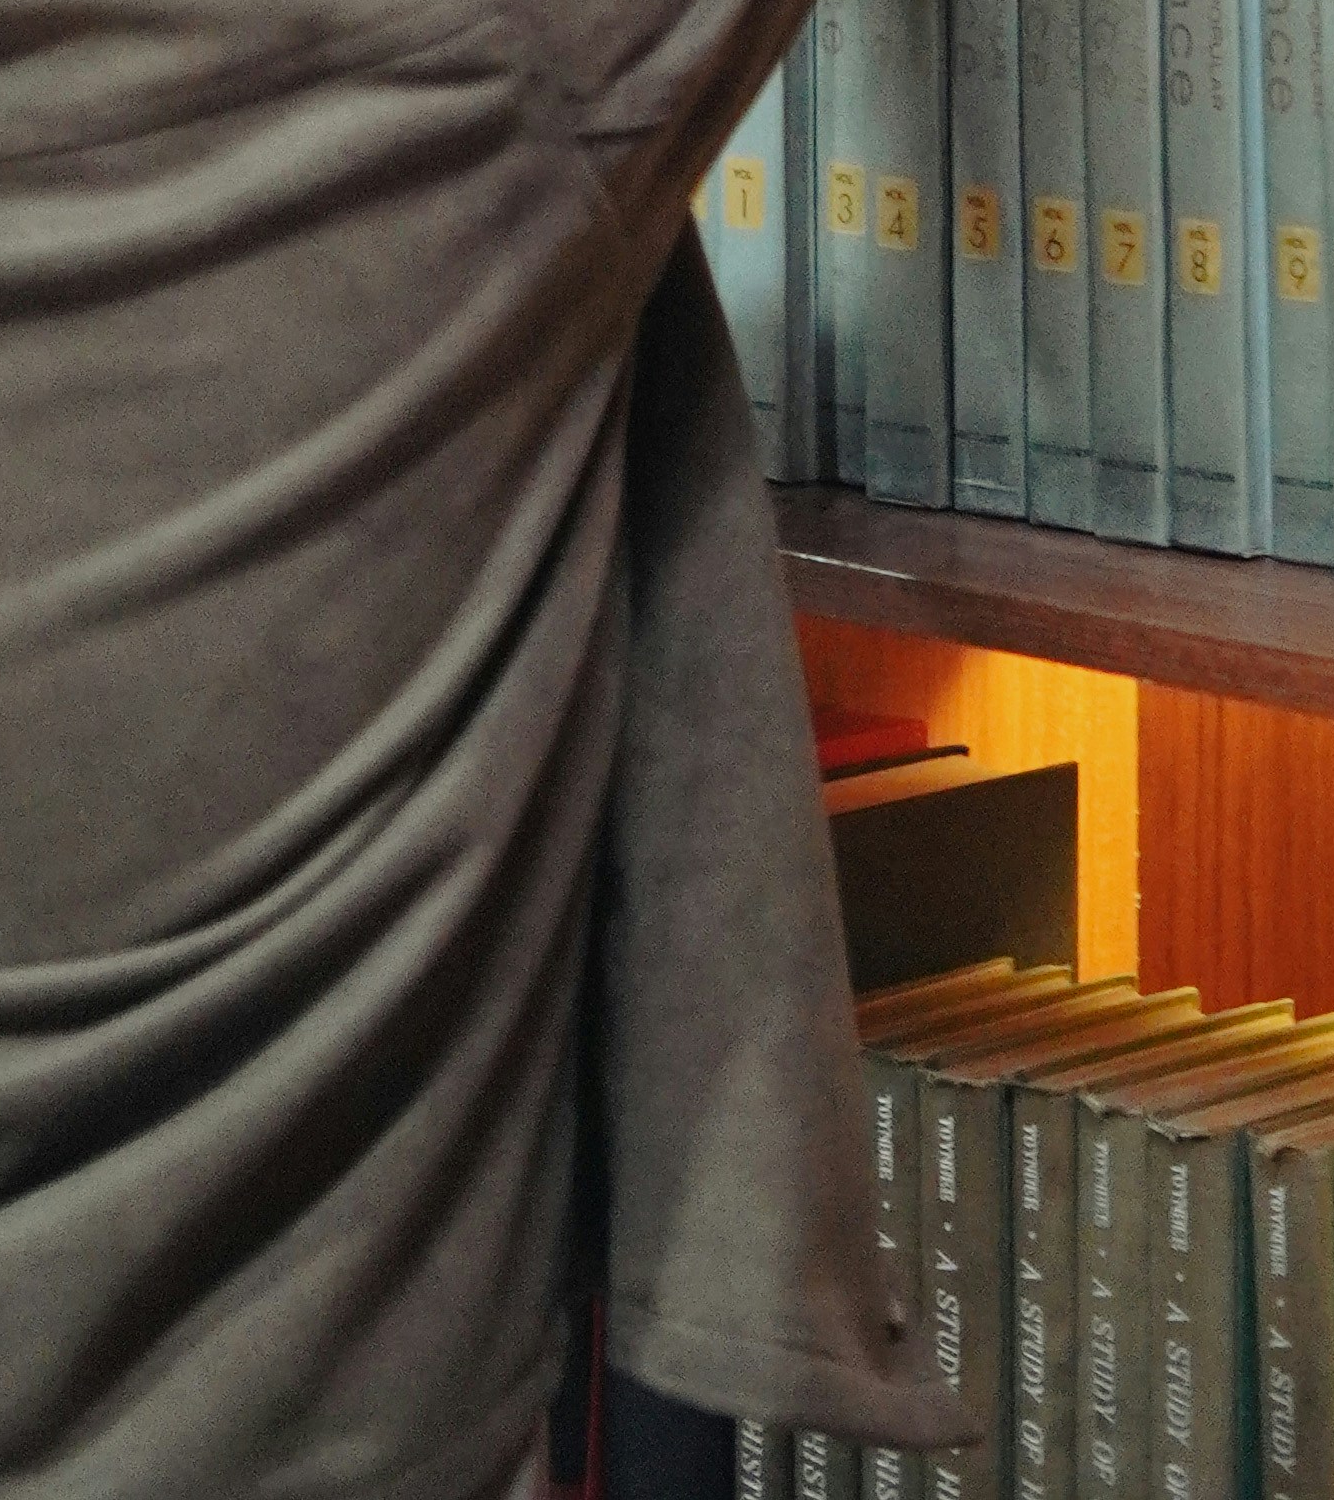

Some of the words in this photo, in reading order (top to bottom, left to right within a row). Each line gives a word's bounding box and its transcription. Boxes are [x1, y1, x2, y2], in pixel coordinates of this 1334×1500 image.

[742, 188, 748, 219] 1
[836, 192, 853, 225] 3
[889, 210, 904, 239] 4
[968, 216, 987, 249] 5
[1045, 228, 1065, 262] 6
[1118, 240, 1137, 274] 7
[1190, 249, 1208, 282] 8
[1289, 257, 1308, 289] 9
[876, 1229, 897, 1250] A
[936, 1248, 958, 1272] A
[1019, 1258, 1043, 1282] A
[1092, 1276, 1113, 1297] A
[1166, 1300, 1190, 1322] A
[1020, 1297, 1045, 1403] STUDY
[1269, 1324, 1292, 1349] A
[1092, 1315, 1116, 1423] STUDY
[1166, 1340, 1193, 1448] STUDY
[1269, 1365, 1295, 1475] STUDY
[1022, 1420, 1045, 1464] OF
[1091, 1438, 1117, 1486] OF
